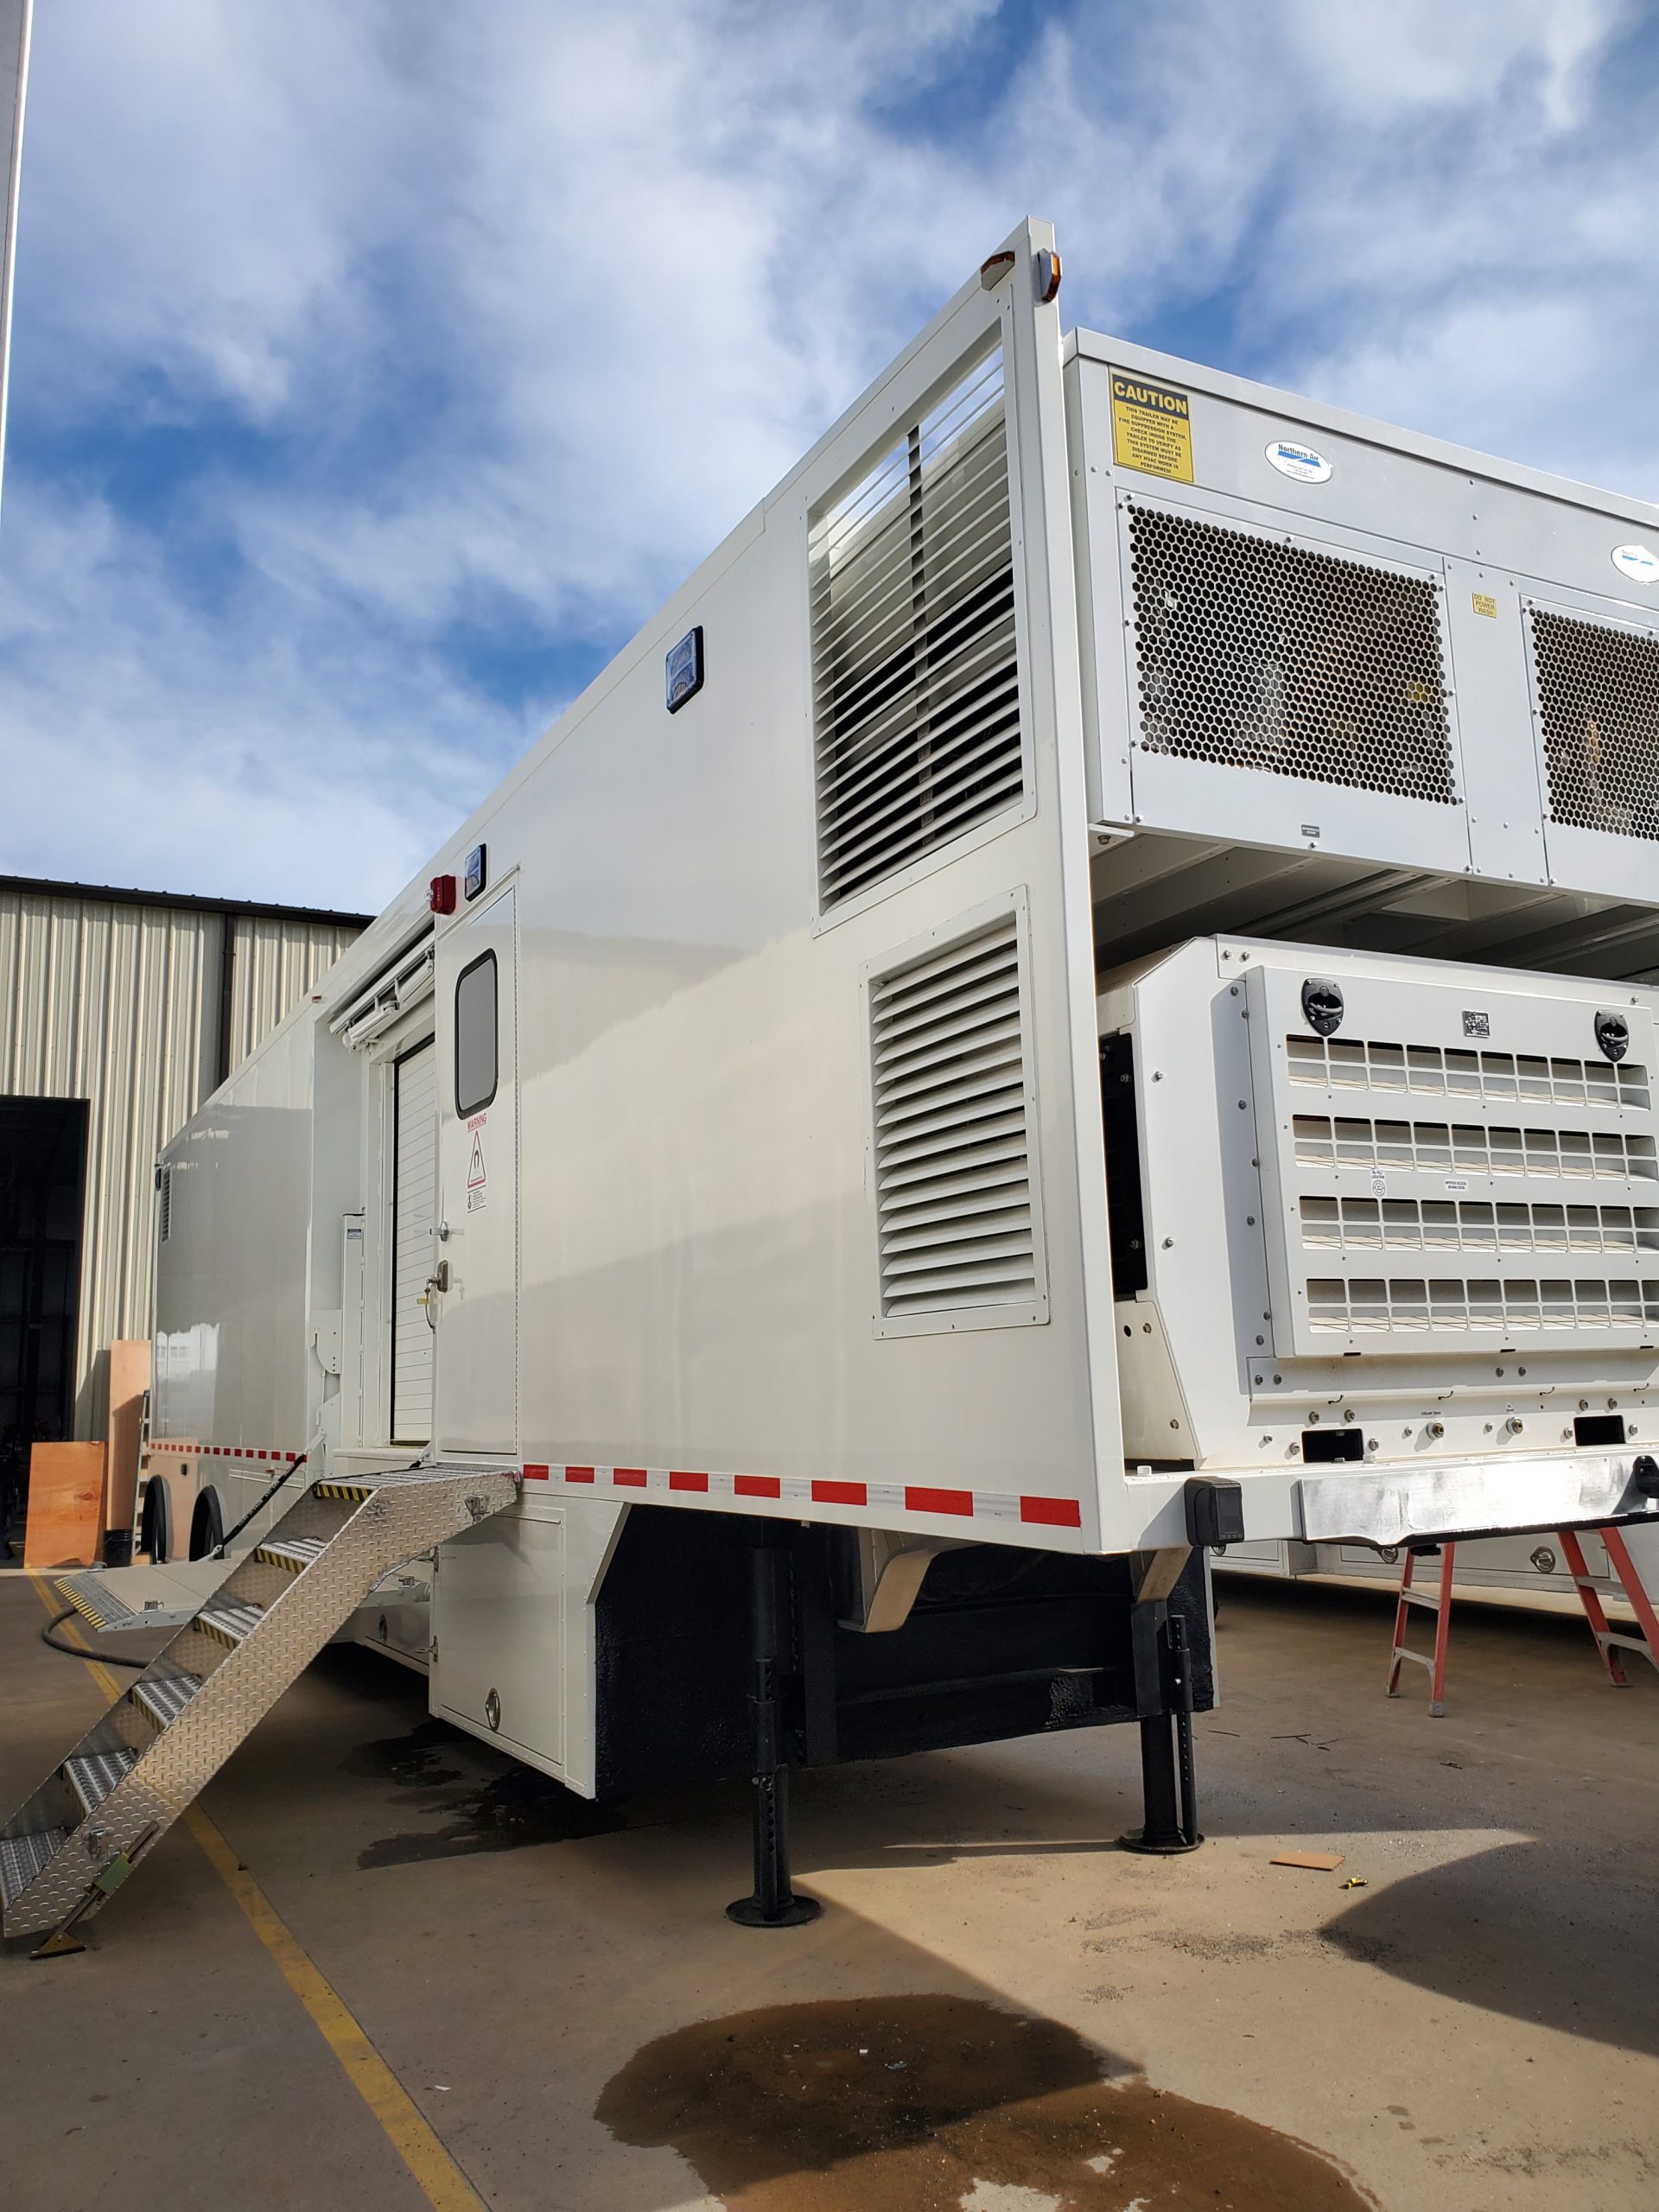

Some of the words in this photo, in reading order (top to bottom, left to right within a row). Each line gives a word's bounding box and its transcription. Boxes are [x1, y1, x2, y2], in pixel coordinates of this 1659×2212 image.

[1115, 381, 1187, 415] CAUTION
[1131, 415, 1155, 426] EQUIPPED
[1139, 410, 1160, 419] TRAILER
[1131, 421, 1166, 435] SUPPRESSION
[1131, 427, 1147, 435] CHECK
[1149, 431, 1166, 440] INSIDE
[1127, 432, 1147, 442] TRAILER
[1156, 440, 1174, 449] VERIFY
[1140, 442, 1160, 452] SYSTEM
[1132, 447, 1157, 458] DISARMED
[1159, 453, 1178, 463] BEFORE
[1279, 444, 1308, 459] Northern
[1141, 462, 1172, 474] PERFORMED!
[1476, 601, 1495, 610] POWER
[467, 1113, 486, 1129] WARNING
